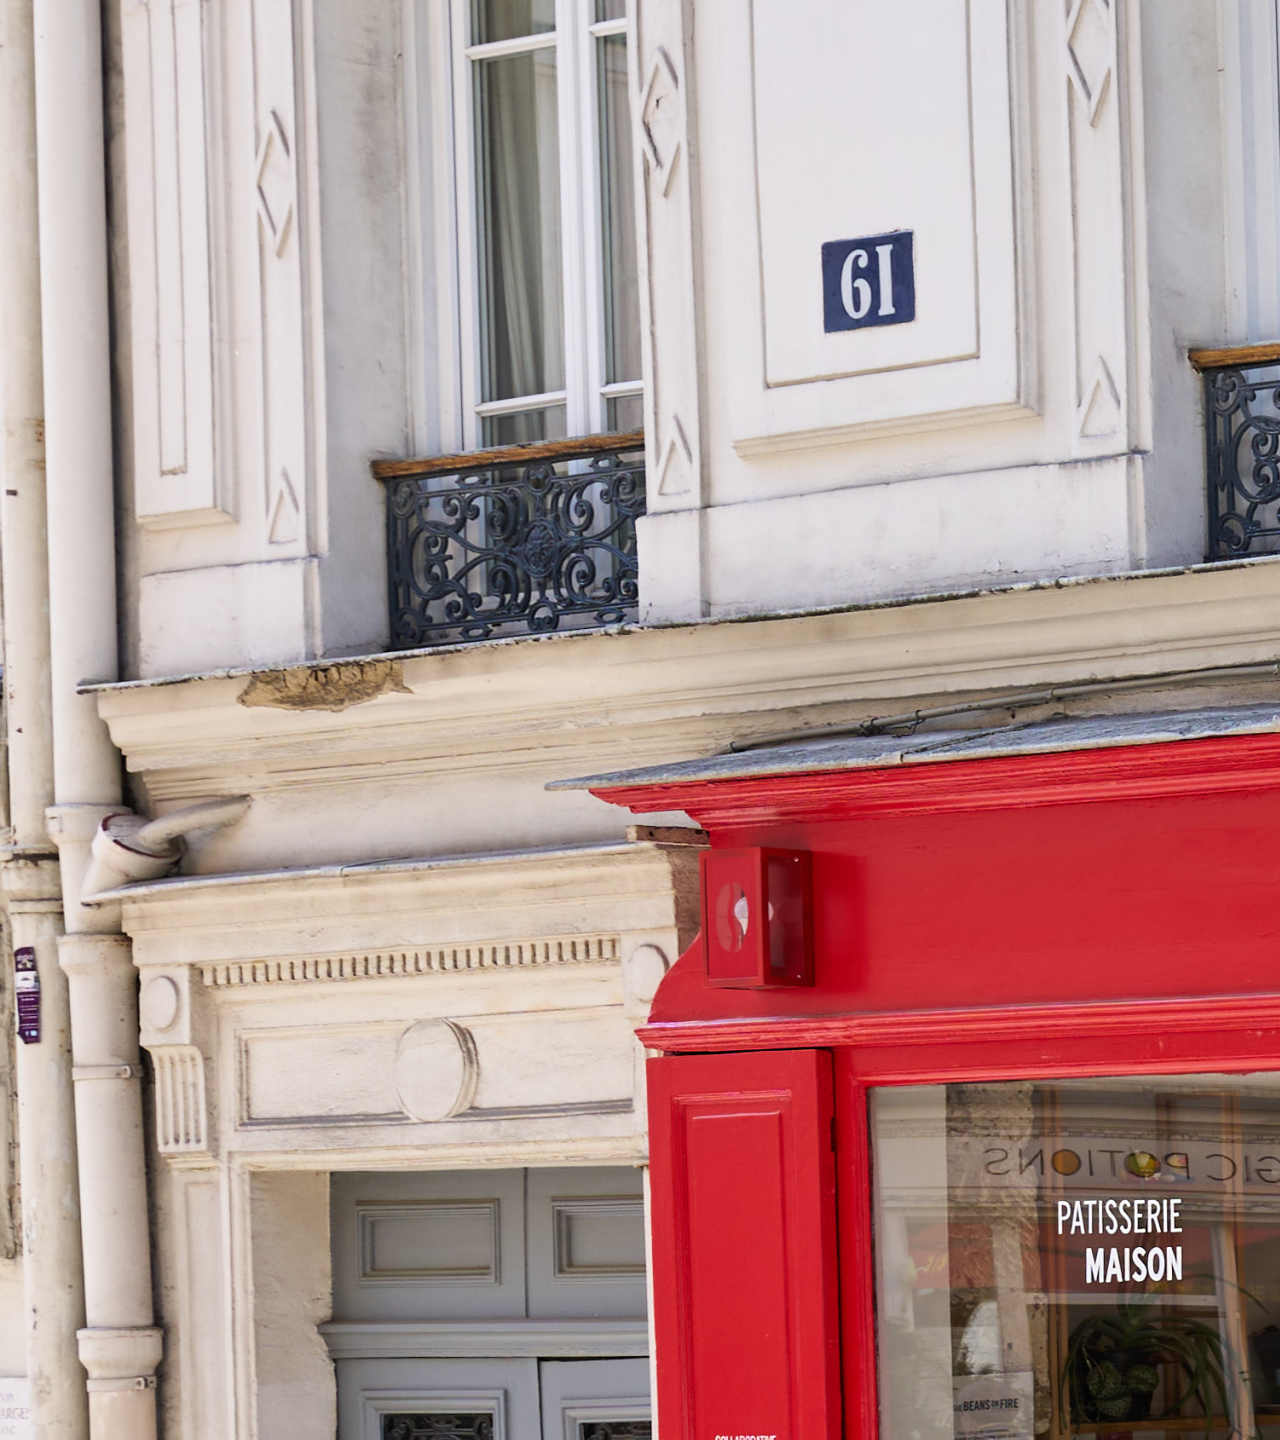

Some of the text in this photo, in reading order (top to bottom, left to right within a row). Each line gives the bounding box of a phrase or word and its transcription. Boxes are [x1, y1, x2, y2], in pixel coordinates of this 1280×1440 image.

[841, 244, 896, 319] 61
[1057, 1198, 1183, 1235] PATISSERIE
[1085, 1246, 1183, 1284] MAISON
[963, 1400, 991, 1411] BEANS
[1000, 1398, 1018, 1409] FIRE
